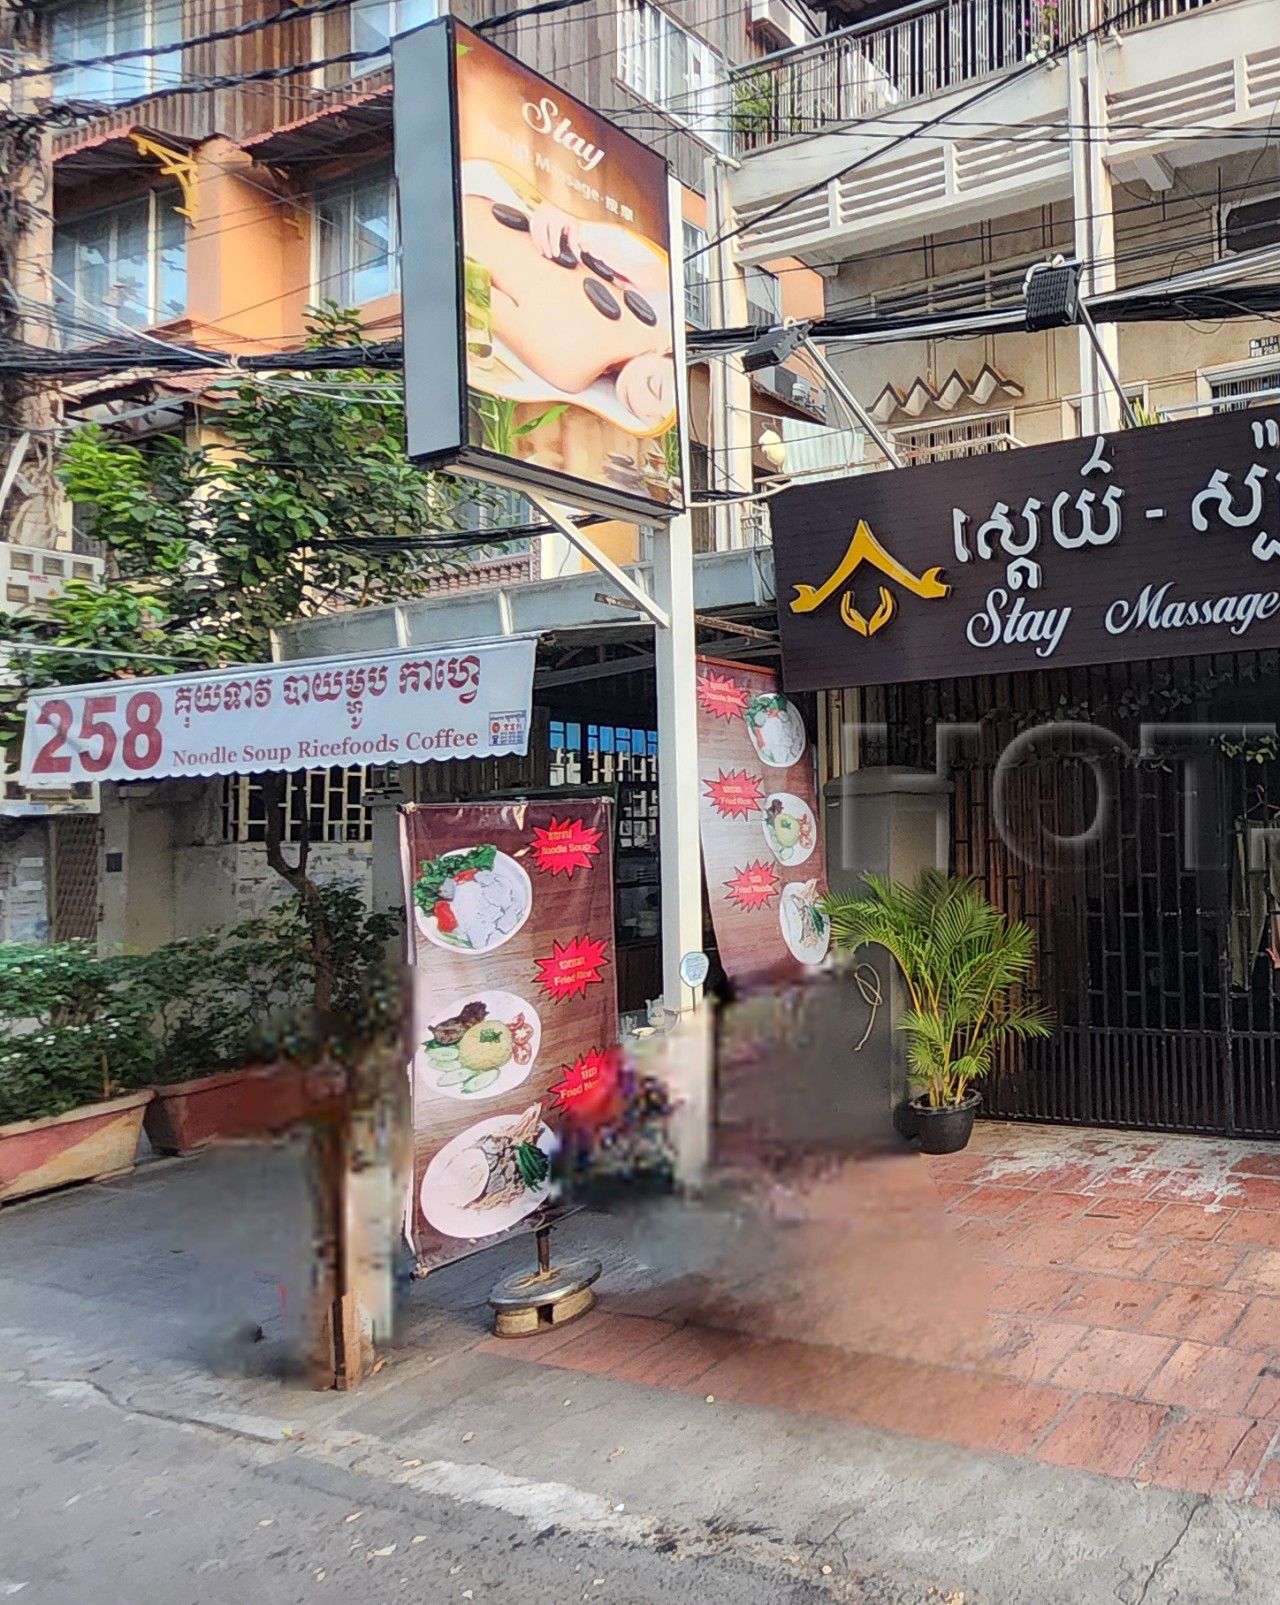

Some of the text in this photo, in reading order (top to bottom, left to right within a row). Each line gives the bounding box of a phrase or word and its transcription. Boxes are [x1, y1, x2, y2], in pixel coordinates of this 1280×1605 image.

[522, 97, 605, 171] Stay
[966, 588, 1072, 658] Stay
[32, 690, 163, 774] 258
[172, 747, 237, 766] Noodle
[242, 743, 292, 763] Soup
[297, 734, 399, 759] Ricefoods
[406, 728, 479, 751] Coffee
